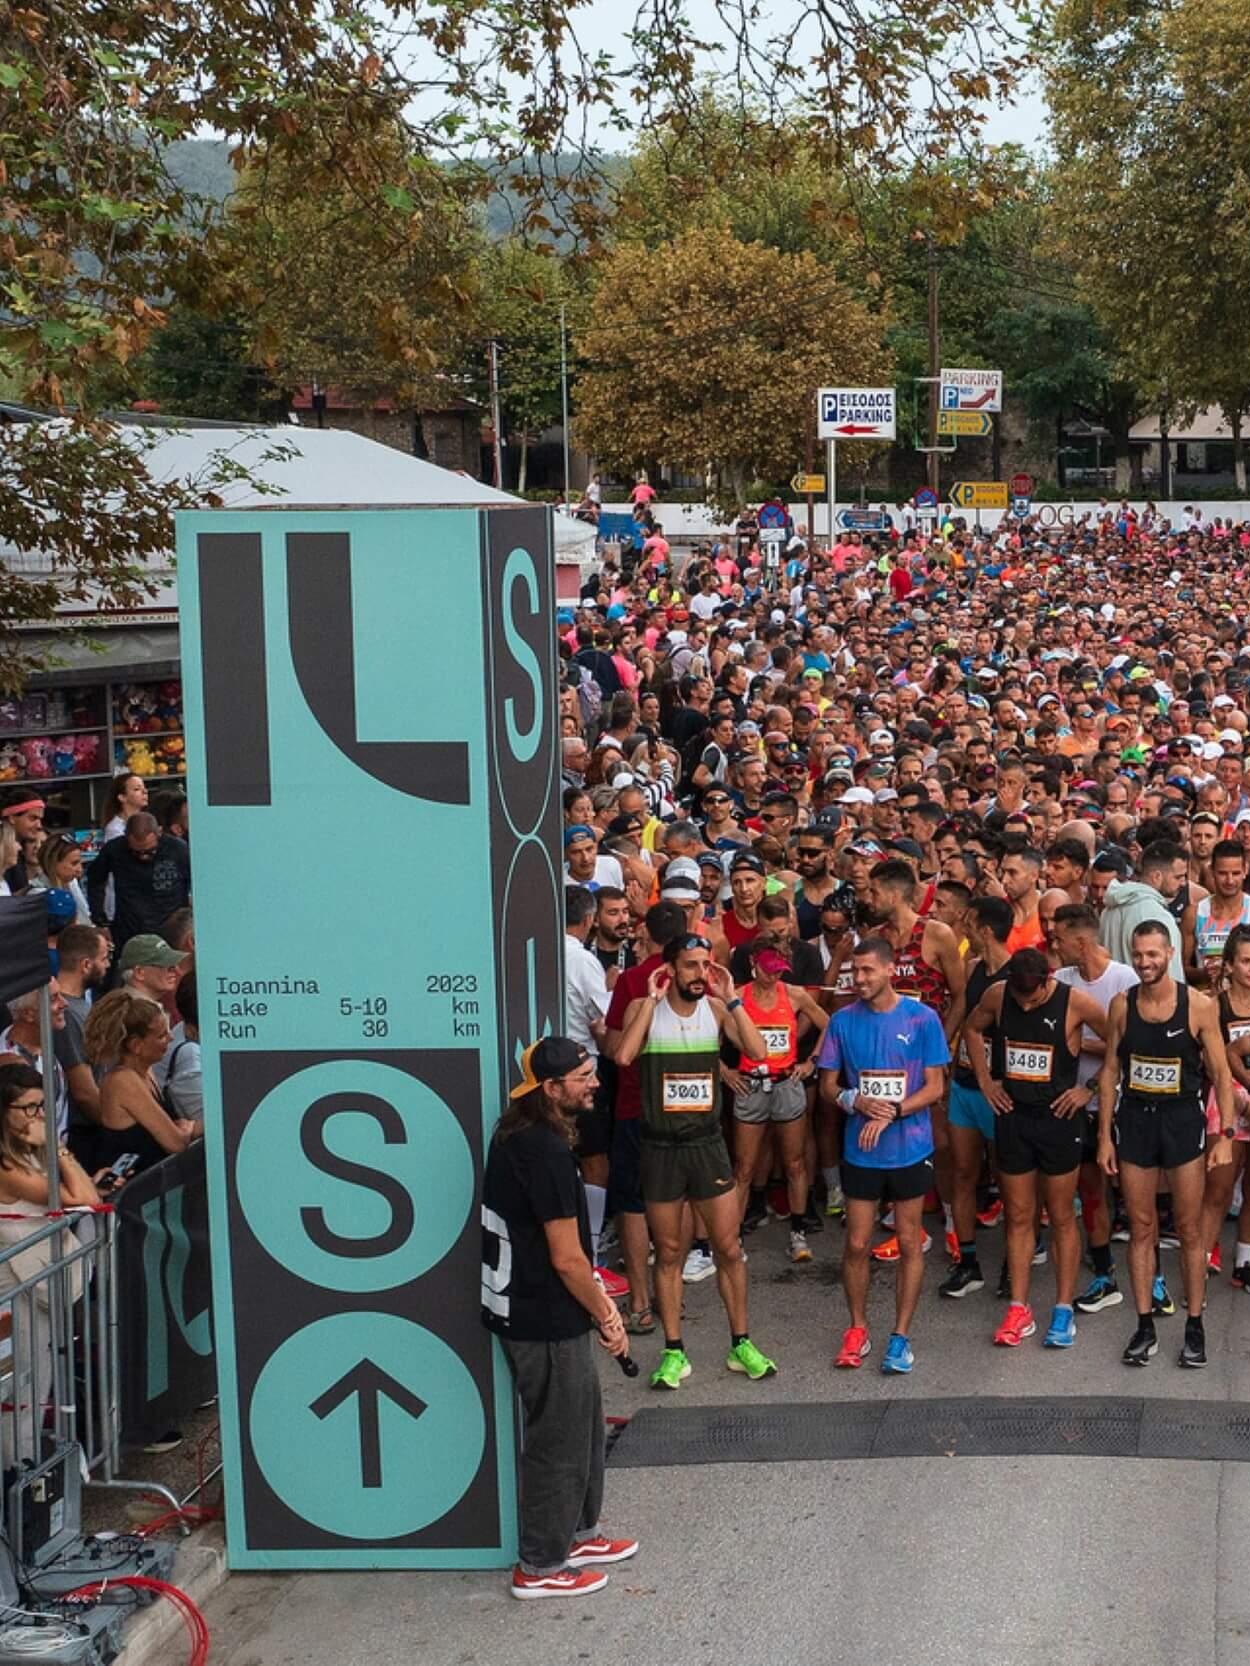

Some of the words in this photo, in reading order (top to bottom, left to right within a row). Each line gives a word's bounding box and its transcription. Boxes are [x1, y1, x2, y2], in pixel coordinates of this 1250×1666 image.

[840, 393, 892, 407] ΕΙΣΟΔΟΣ
[840, 409, 892, 423] PARKING
[216, 976, 320, 995] Ioannina
[426, 975, 478, 993] 2023
[217, 999, 269, 1017] Lake
[340, 997, 388, 1016] 5-10
[452, 997, 480, 1015] km
[218, 1020, 257, 1039] Run
[362, 1019, 389, 1038] 30
[453, 1019, 481, 1037] km
[764, 1033, 788, 1048] 23
[1008, 1051, 1049, 1069] 3488
[1132, 1065, 1177, 1083] 4252
[667, 1083, 710, 1099] 3001
[862, 1081, 903, 1096] 3013
[300, 1091, 415, 1259] S
